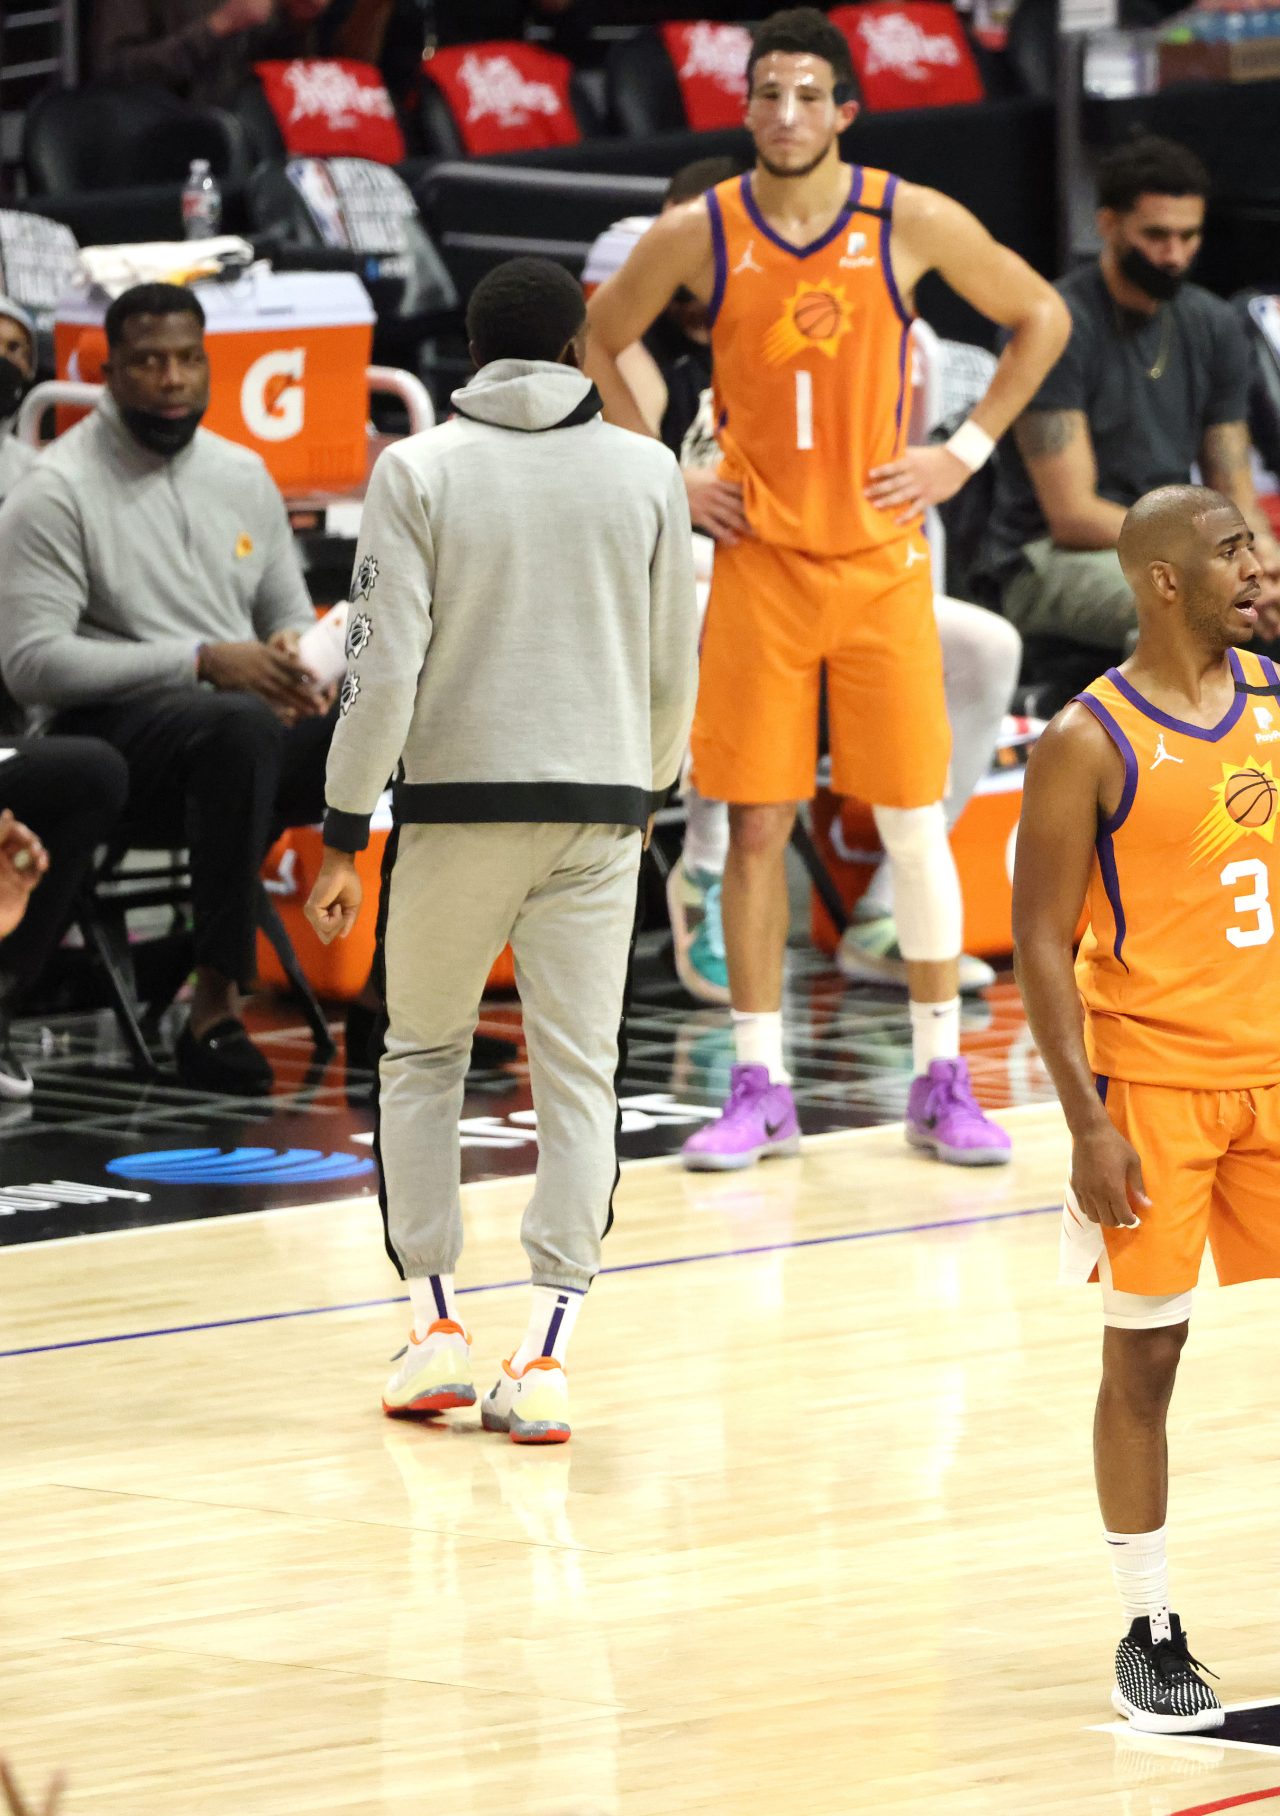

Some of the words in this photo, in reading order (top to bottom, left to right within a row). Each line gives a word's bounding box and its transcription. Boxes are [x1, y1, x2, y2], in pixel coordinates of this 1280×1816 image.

[240, 347, 305, 442] G
[796, 370, 812, 449] 1
[1220, 858, 1274, 948] 3
